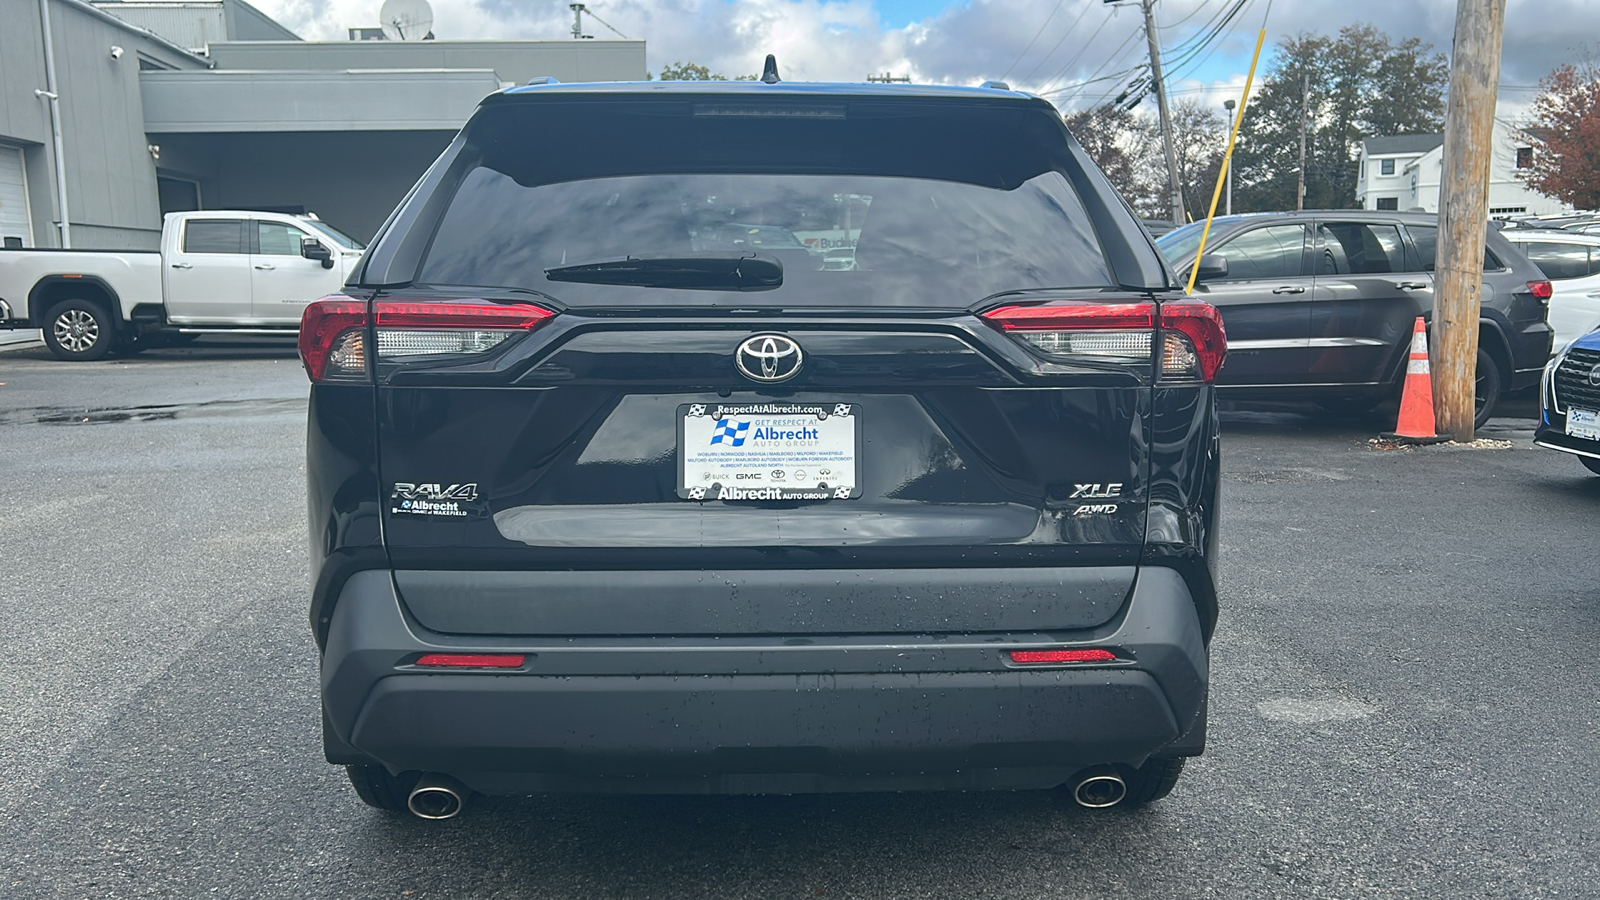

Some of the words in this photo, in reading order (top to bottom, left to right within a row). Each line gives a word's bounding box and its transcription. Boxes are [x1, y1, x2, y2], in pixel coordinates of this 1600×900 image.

[717, 405, 822, 415] RespectAtAlbrecht.com
[753, 426, 818, 440] Albrecht
[391, 482, 479, 501] RAV4
[718, 487, 782, 500] Albrecht
[1069, 483, 1123, 498] XLE
[411, 501, 459, 511] Albrecht
[1073, 504, 1118, 516] AWD
